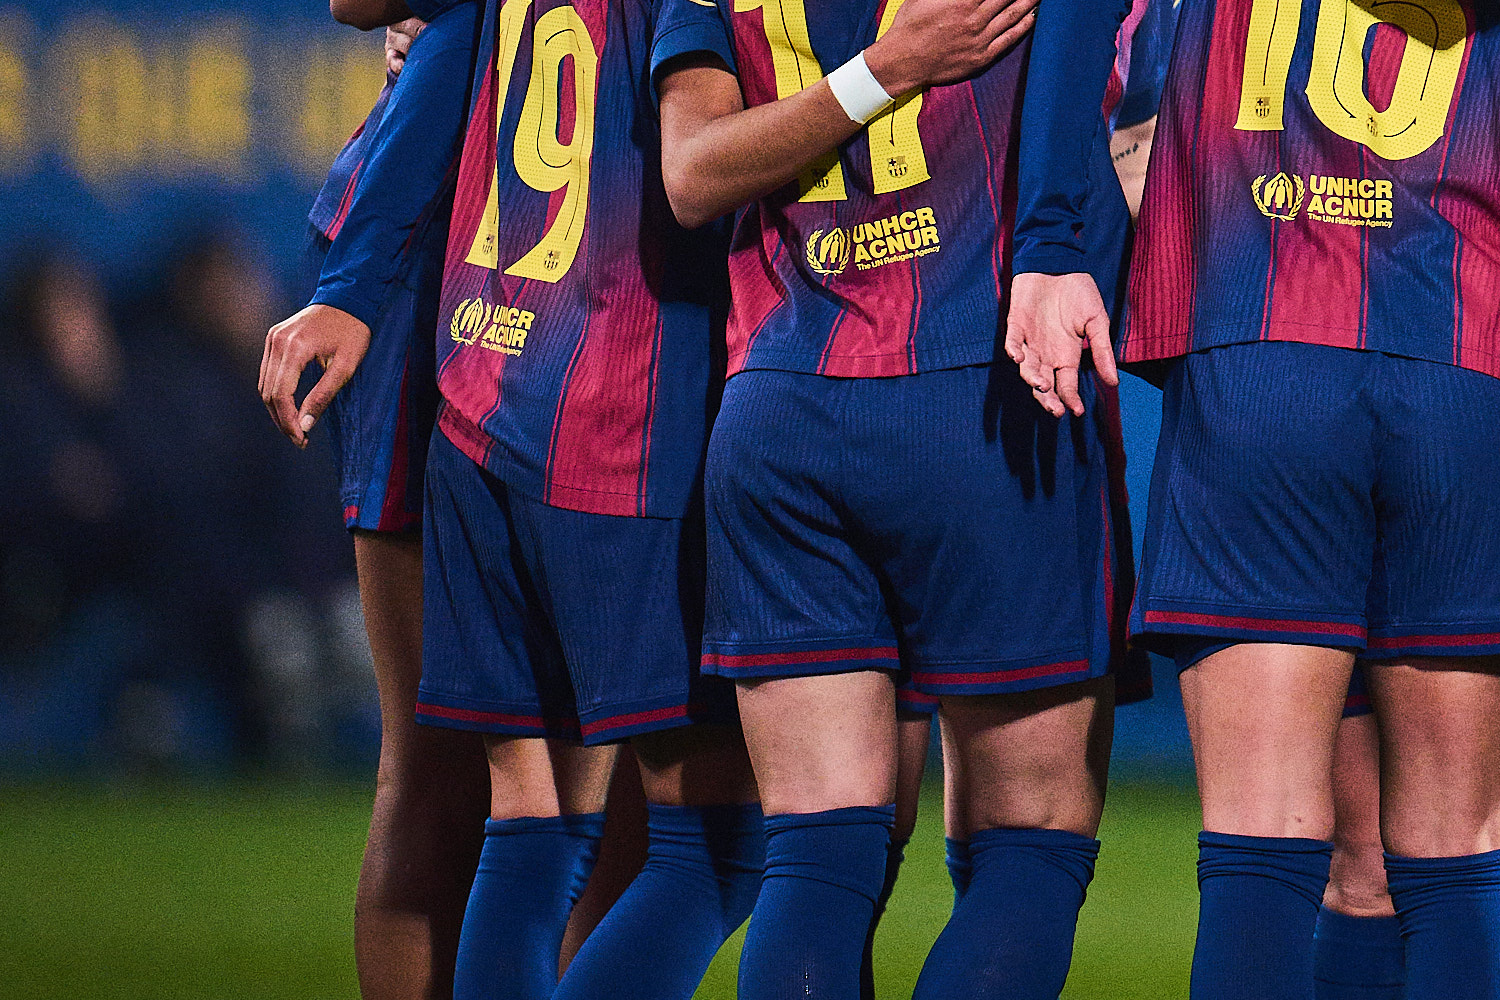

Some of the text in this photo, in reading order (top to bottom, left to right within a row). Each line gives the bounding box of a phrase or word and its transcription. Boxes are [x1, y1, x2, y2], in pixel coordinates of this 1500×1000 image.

[1309, 174, 1393, 199] UNHCR
[1307, 195, 1393, 219] ACNUR
[852, 206, 937, 244] UNHCR
[1307, 212, 1393, 228] The UN Refugee Agency
[854, 226, 940, 263] ACNUR
[856, 245, 941, 271] The UN Refugee Agency
